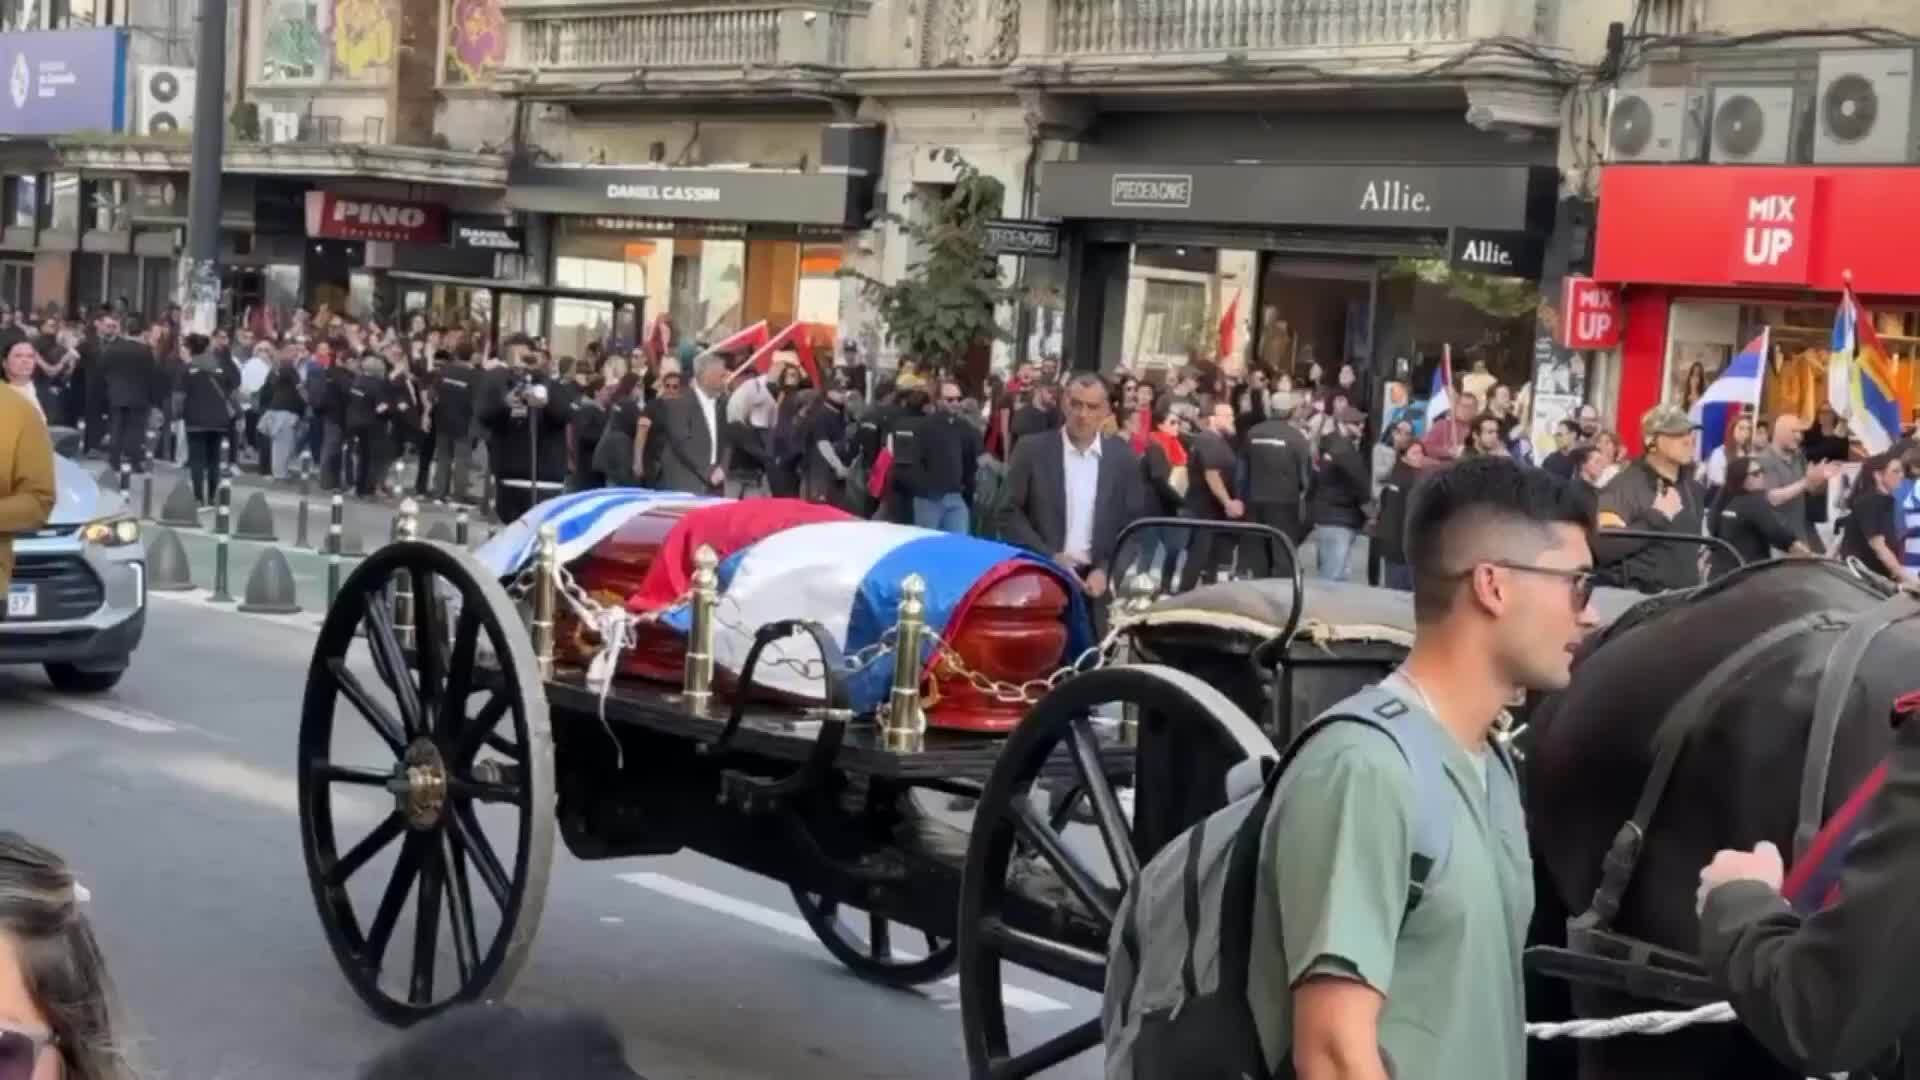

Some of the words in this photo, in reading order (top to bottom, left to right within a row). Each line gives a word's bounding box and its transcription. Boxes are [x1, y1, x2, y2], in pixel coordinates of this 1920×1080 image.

[607, 184, 657, 199] DANIEL
[662, 186, 720, 201] CASSIN
[1115, 180, 1188, 201] PIECE&CAKE
[1360, 180, 1431, 212] Allie.
[333, 201, 425, 228] PINO
[1748, 196, 1796, 222] MIX
[1461, 239, 1513, 265] Allie.
[1743, 227, 1794, 265] UP
[1580, 290, 1613, 309] MIX
[1578, 312, 1611, 340] UP
